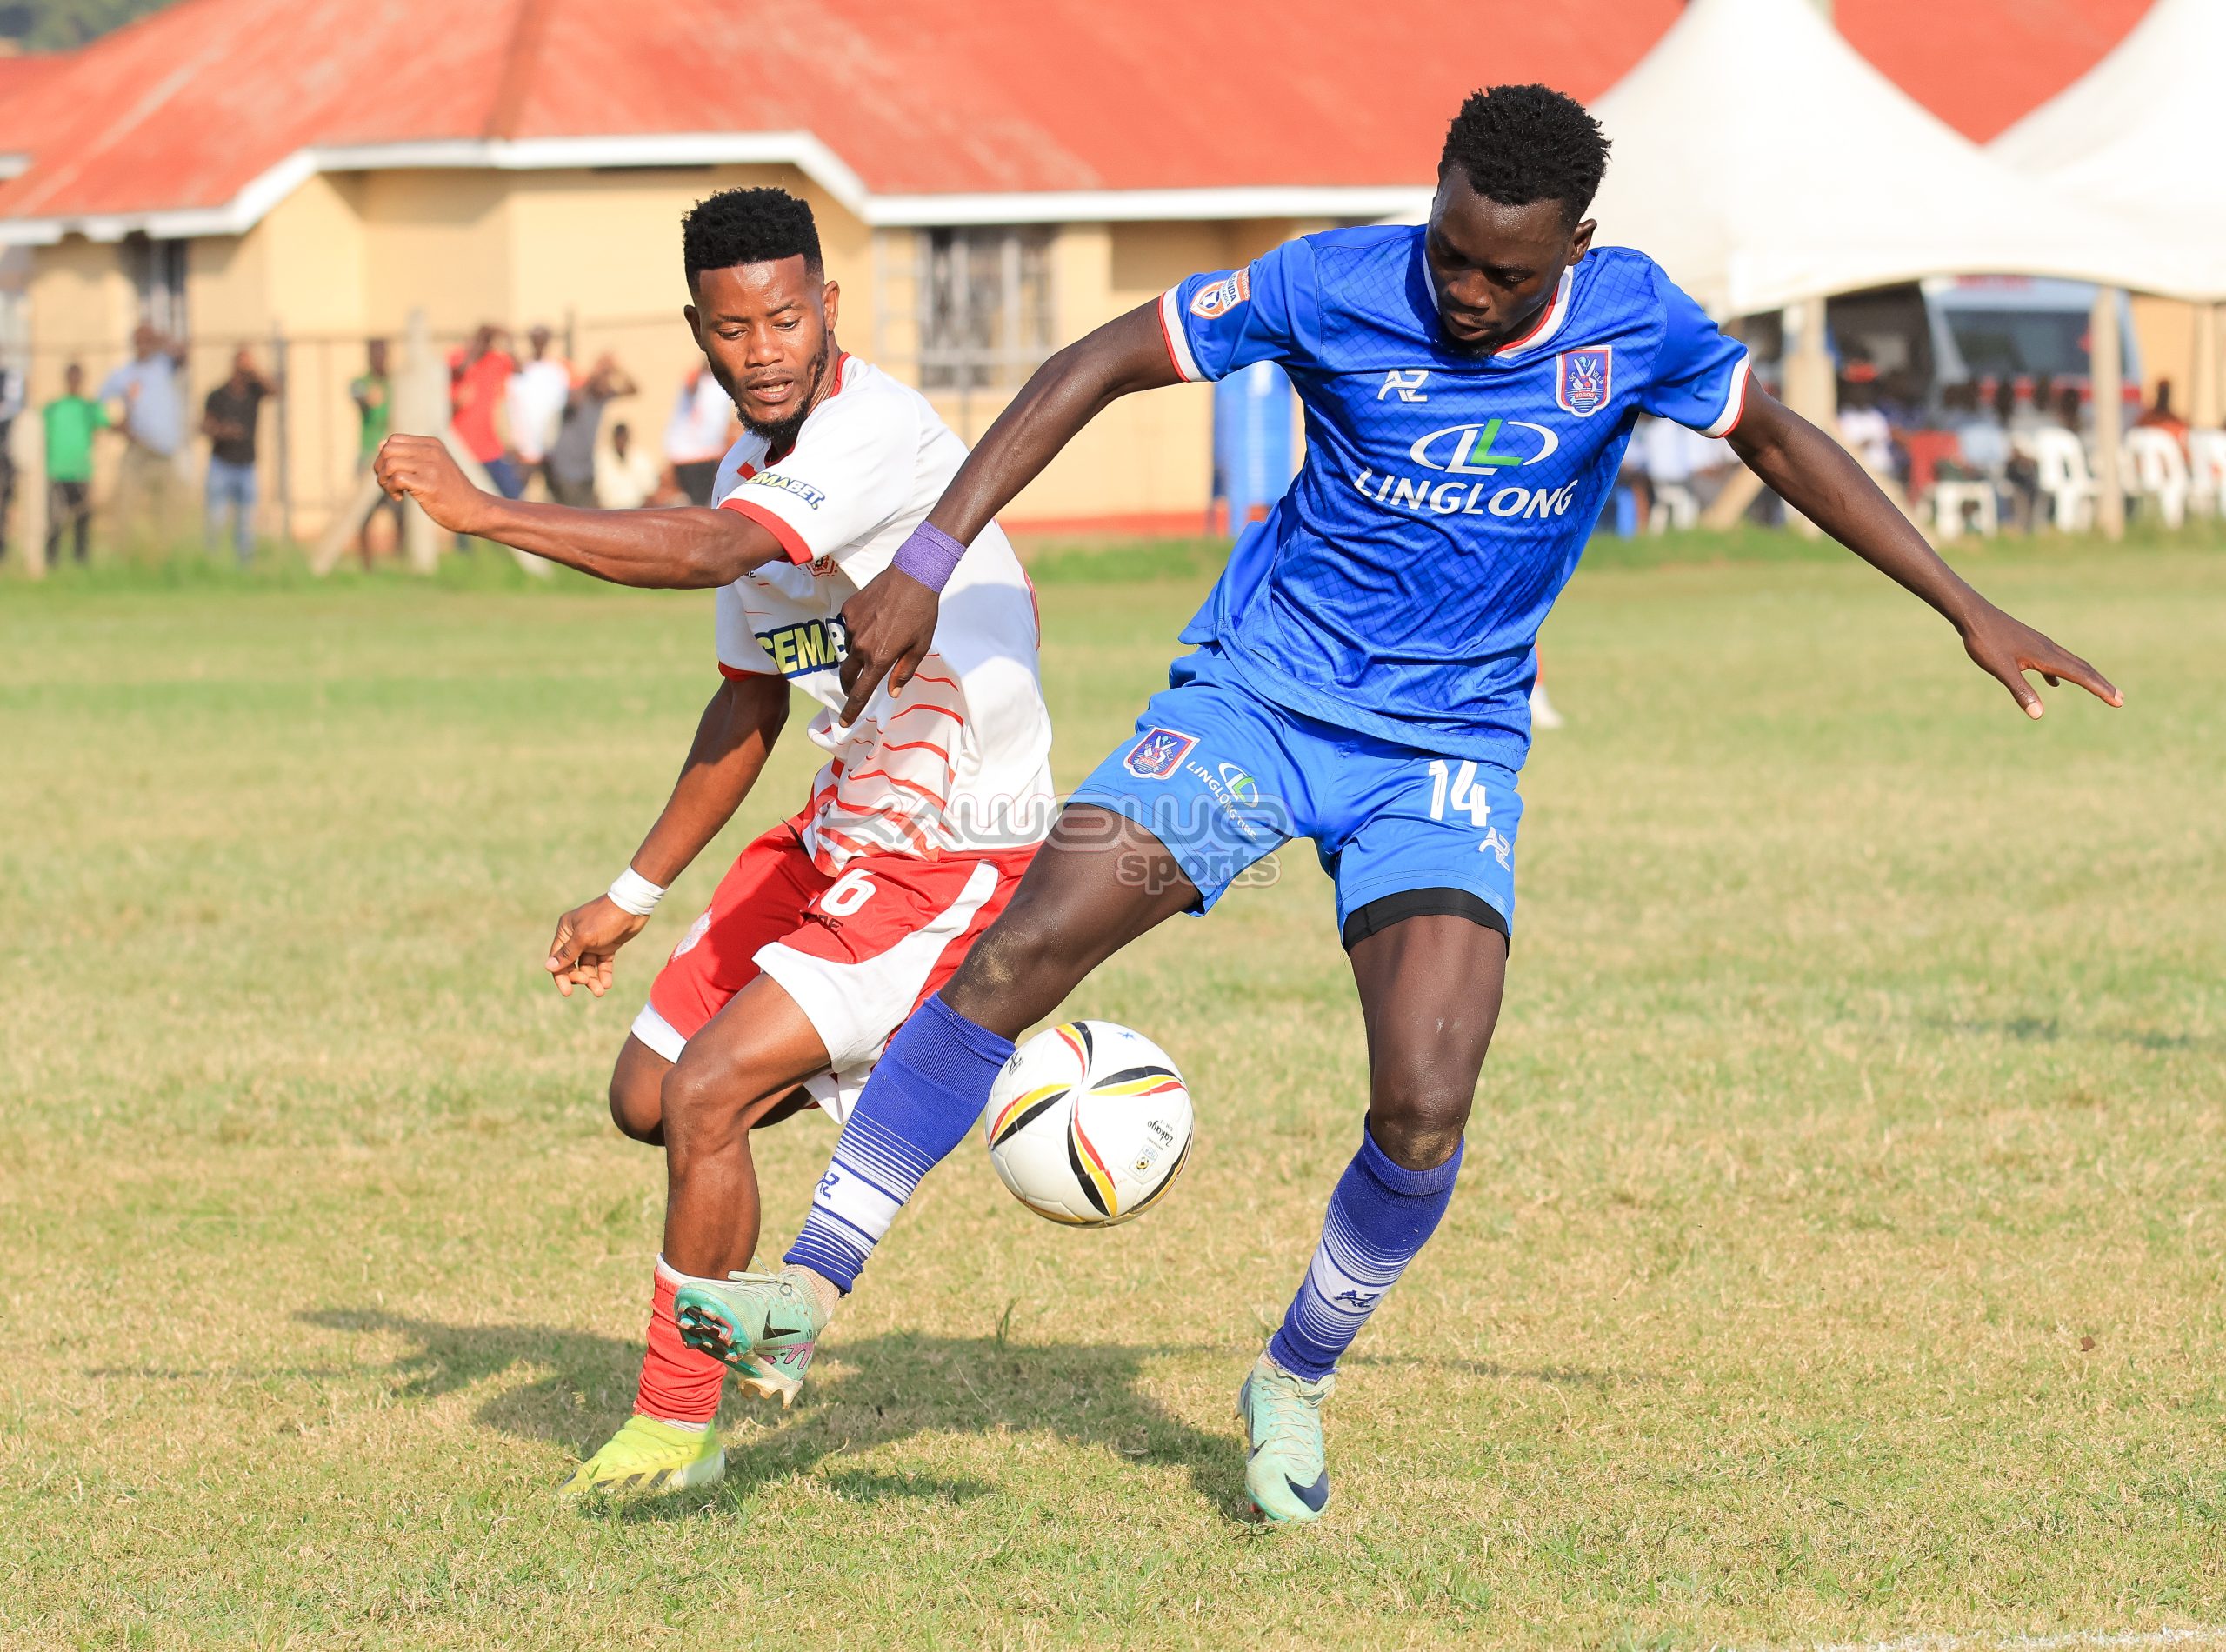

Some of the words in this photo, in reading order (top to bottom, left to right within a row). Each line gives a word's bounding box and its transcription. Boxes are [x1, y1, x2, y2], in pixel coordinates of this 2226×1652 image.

[1569, 372, 1577, 382] SC
[1592, 370, 1604, 385] VILLA
[1354, 467, 1579, 520] LINGLONG
[1185, 761, 1238, 820] LINGLONG
[1428, 759, 1491, 827] 14
[809, 868, 877, 917] 6
[1147, 1120, 1174, 1147] Zakayo
